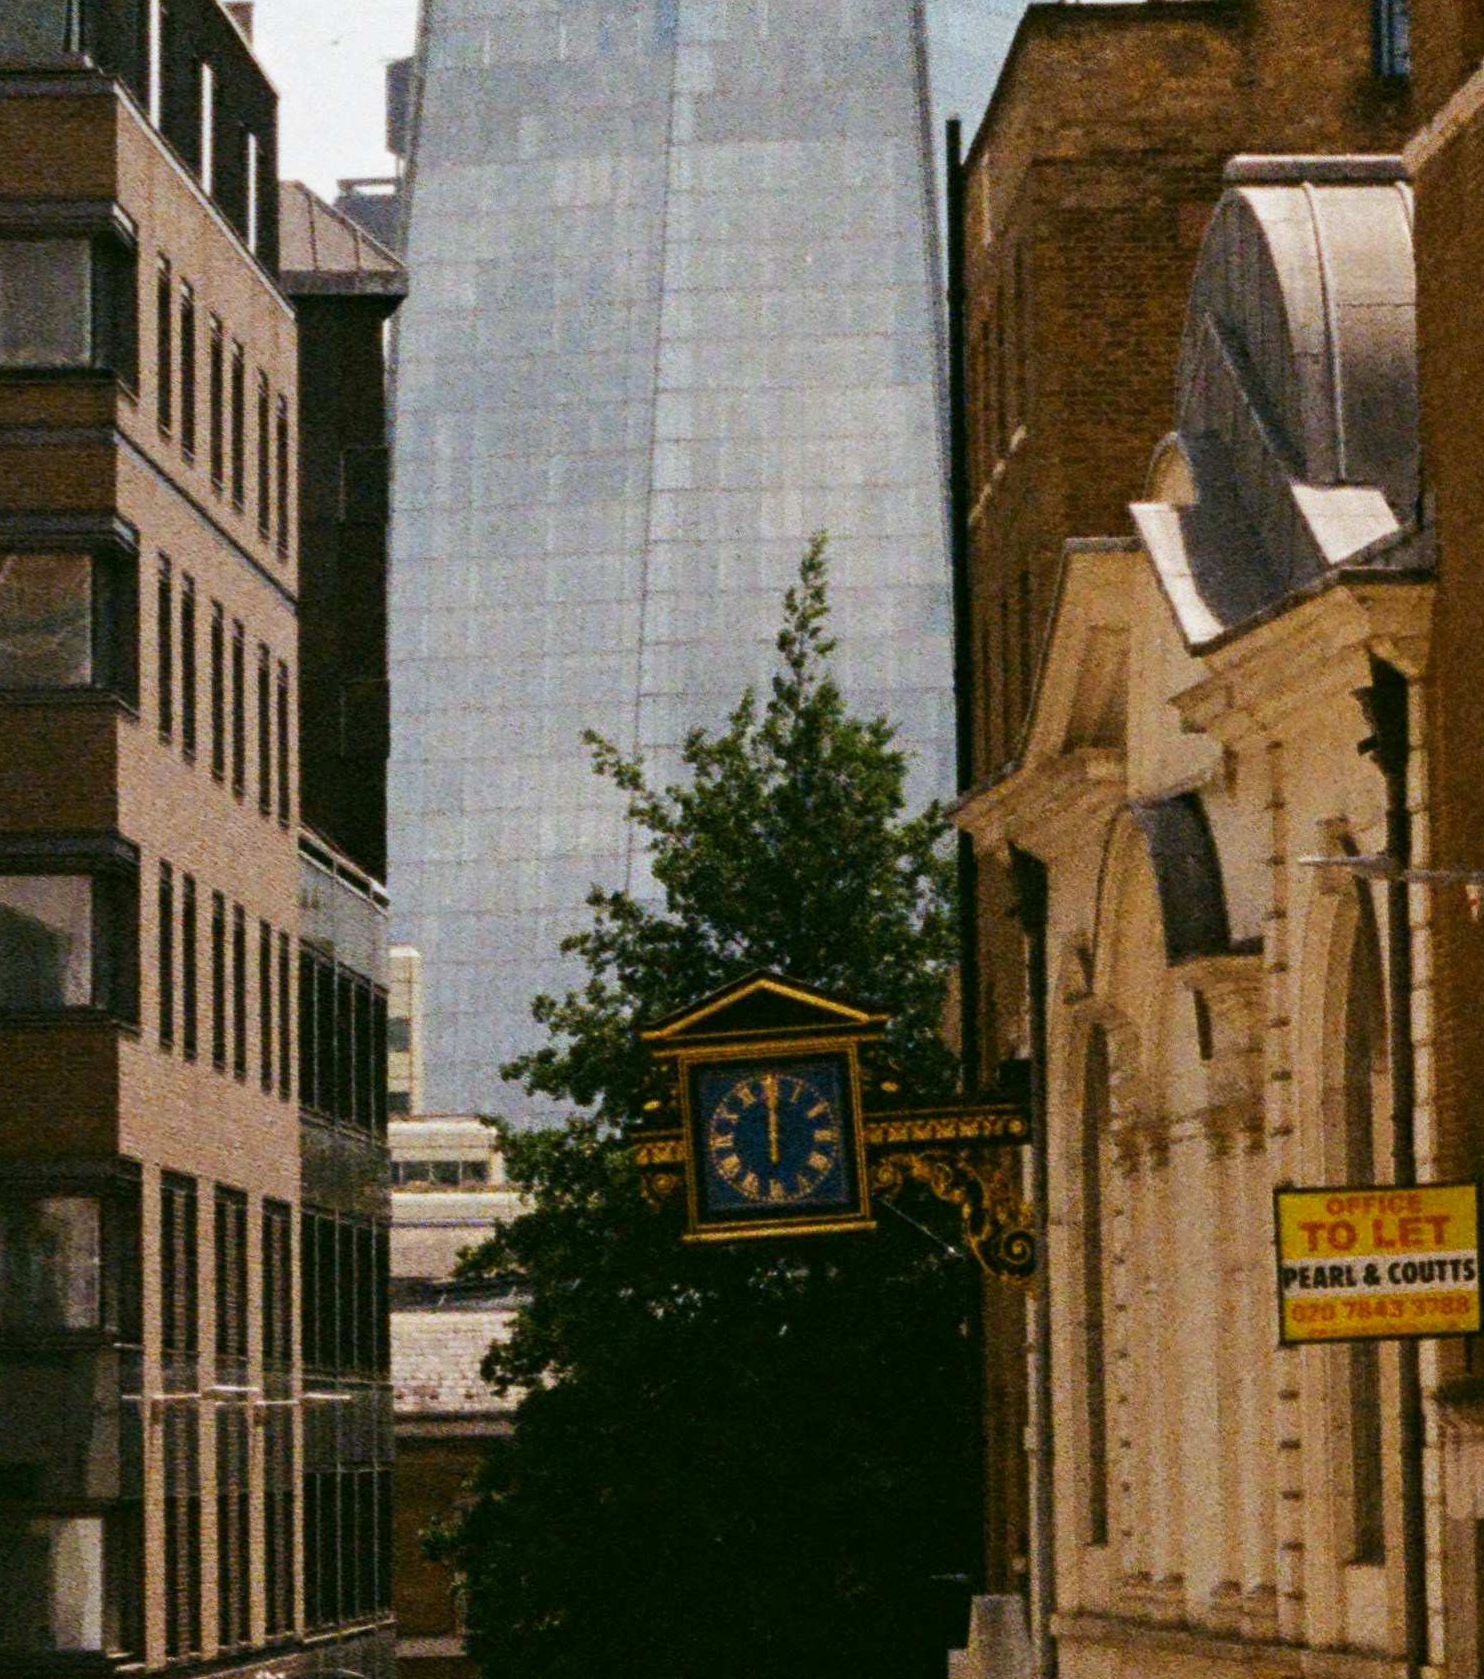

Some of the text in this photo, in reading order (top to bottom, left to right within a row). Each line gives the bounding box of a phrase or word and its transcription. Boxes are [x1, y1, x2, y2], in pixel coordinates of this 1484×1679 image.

[1325, 1193, 1422, 1216] OFFICE
[1298, 1215, 1451, 1252] TO LET
[1282, 1258, 1476, 1289] PEARL & COUTTS
